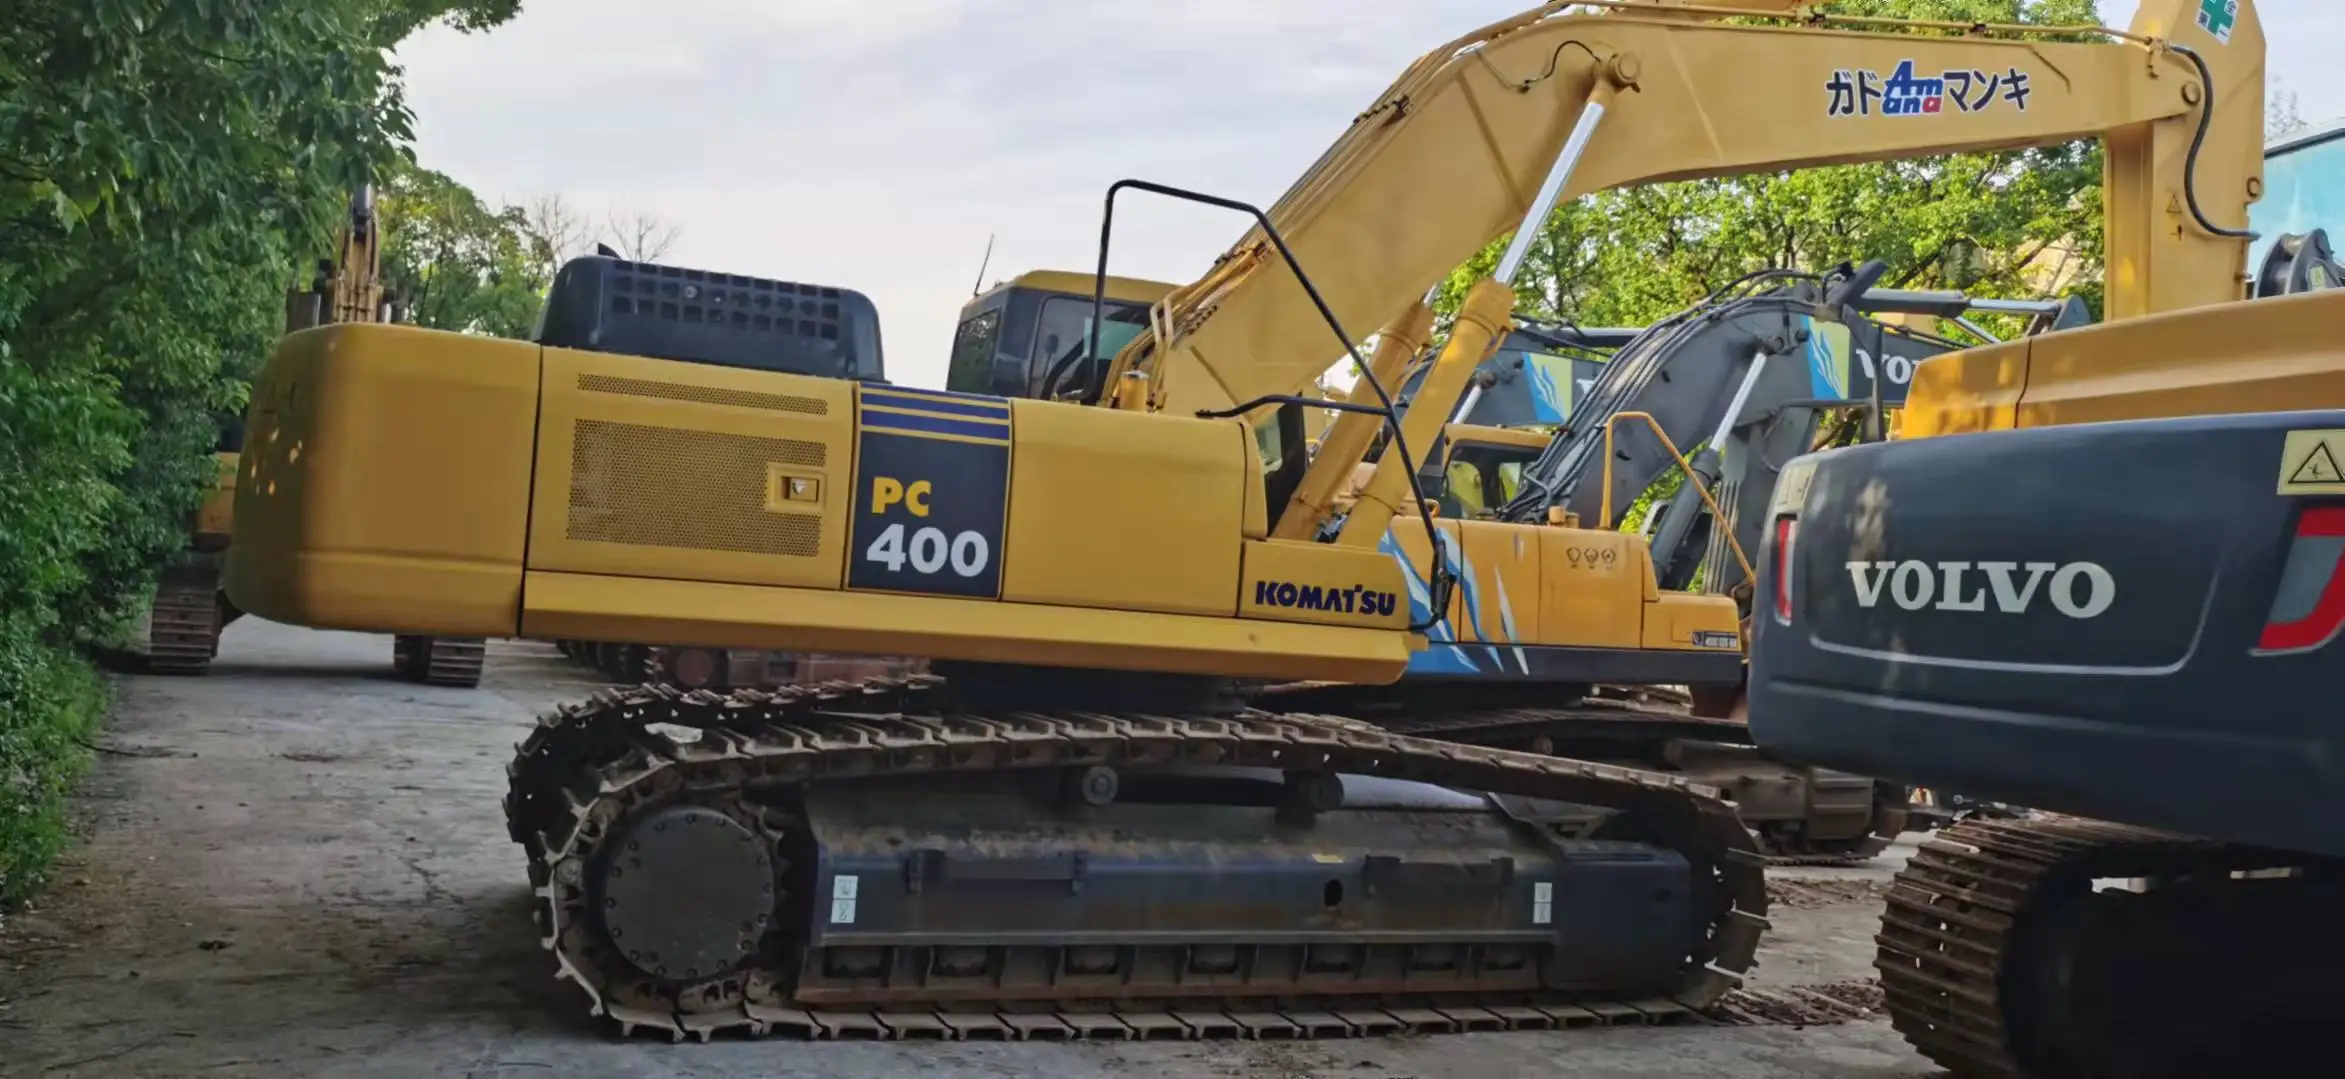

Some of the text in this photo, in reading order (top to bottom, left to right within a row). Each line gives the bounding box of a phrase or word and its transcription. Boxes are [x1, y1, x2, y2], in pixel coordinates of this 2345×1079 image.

[871, 476, 932, 517] PC
[866, 523, 989, 577] 400
[1254, 580, 1397, 617] KOMATSU
[1845, 559, 2116, 619] VOLVO
